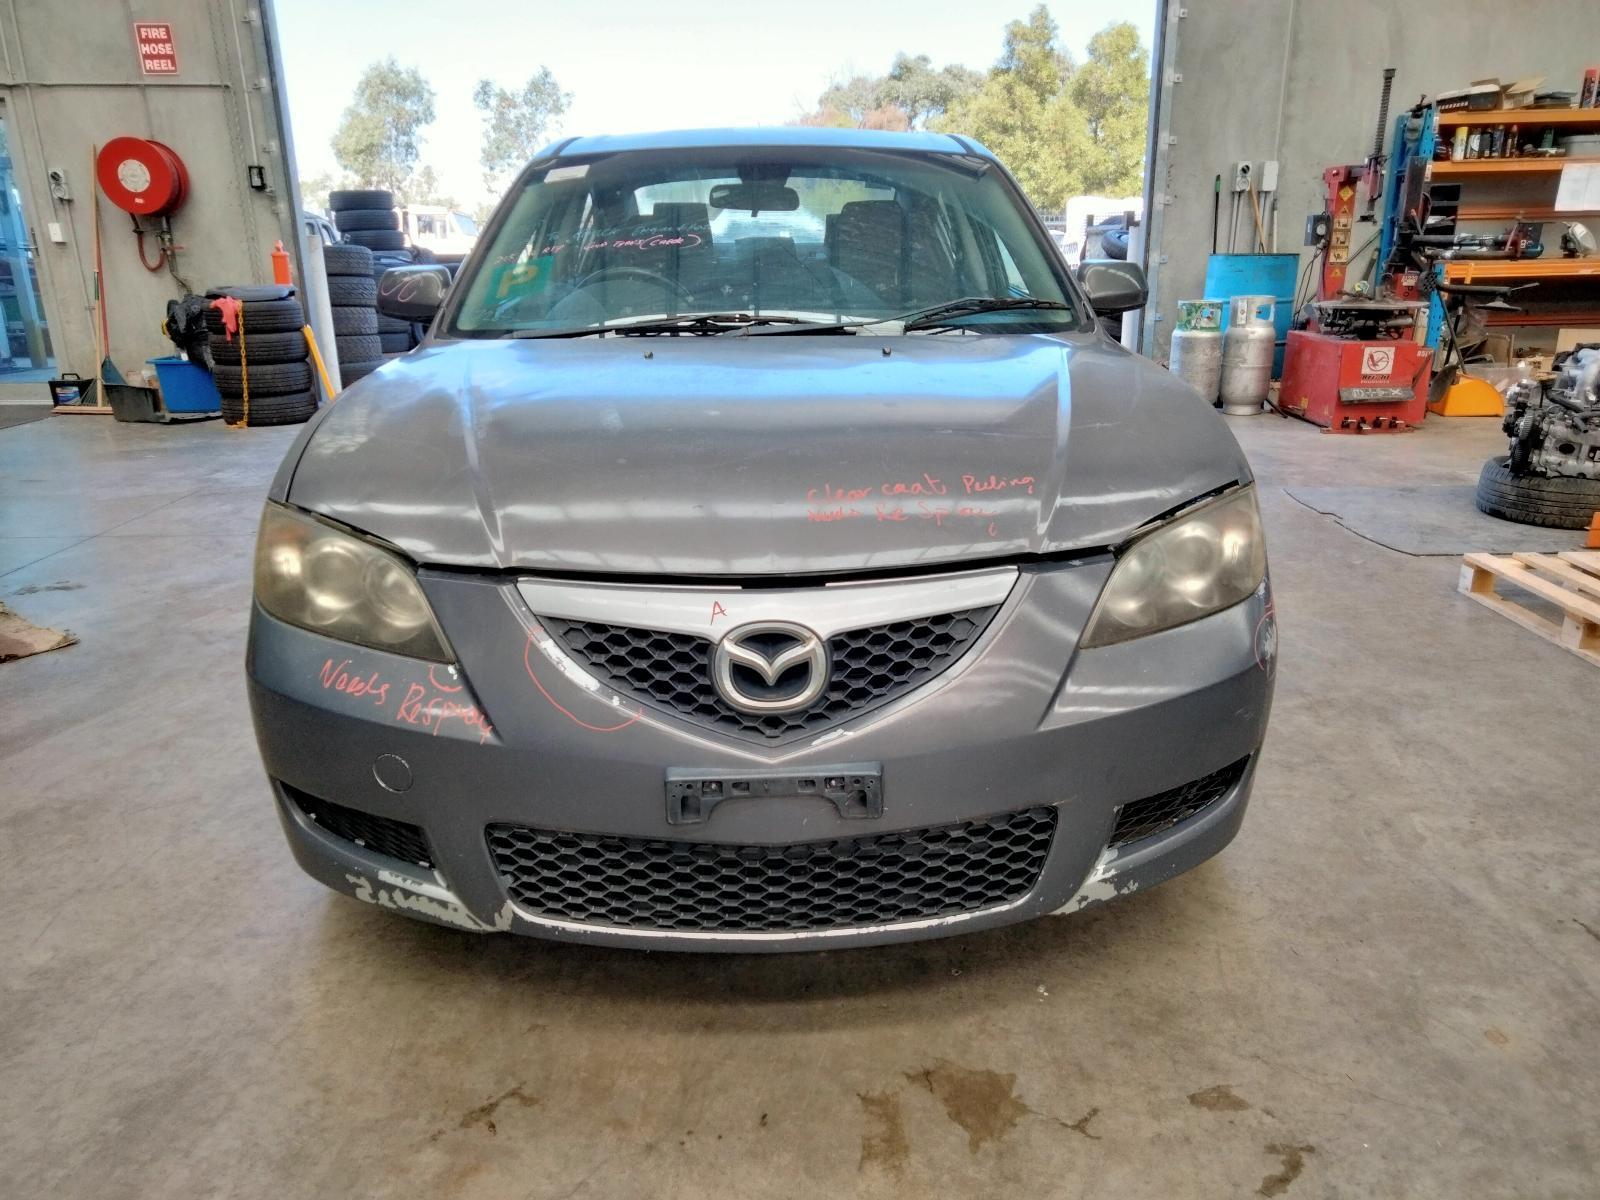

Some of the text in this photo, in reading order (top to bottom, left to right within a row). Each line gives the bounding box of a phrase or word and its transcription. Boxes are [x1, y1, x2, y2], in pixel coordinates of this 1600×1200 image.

[140, 27, 168, 39] FIRE
[140, 43, 174, 55] HOSE
[144, 59, 176, 70] REEL
[710, 600, 728, 625] A
